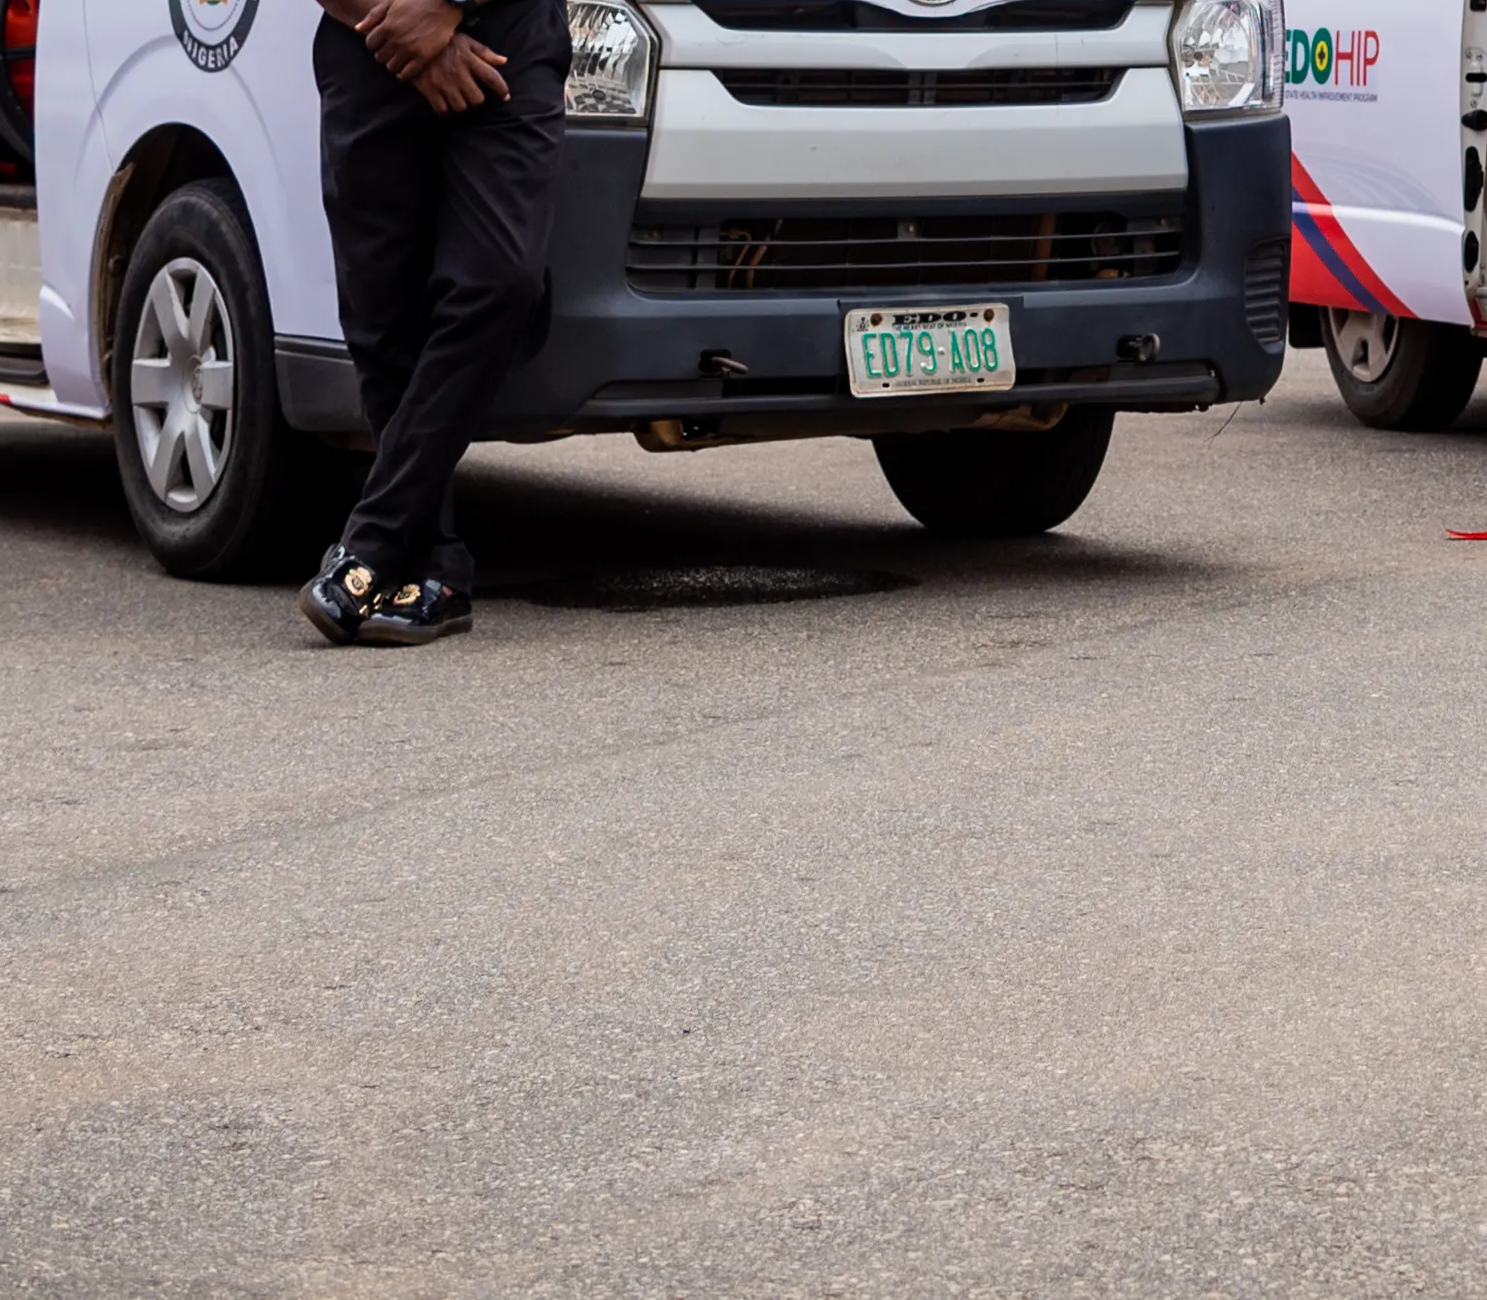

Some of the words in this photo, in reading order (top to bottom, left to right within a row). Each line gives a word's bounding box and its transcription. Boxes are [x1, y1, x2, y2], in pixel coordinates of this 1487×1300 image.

[182, 29, 239, 70] NIGERIA
[893, 311, 967, 325] EDO
[863, 327, 999, 378] ED79-A08
